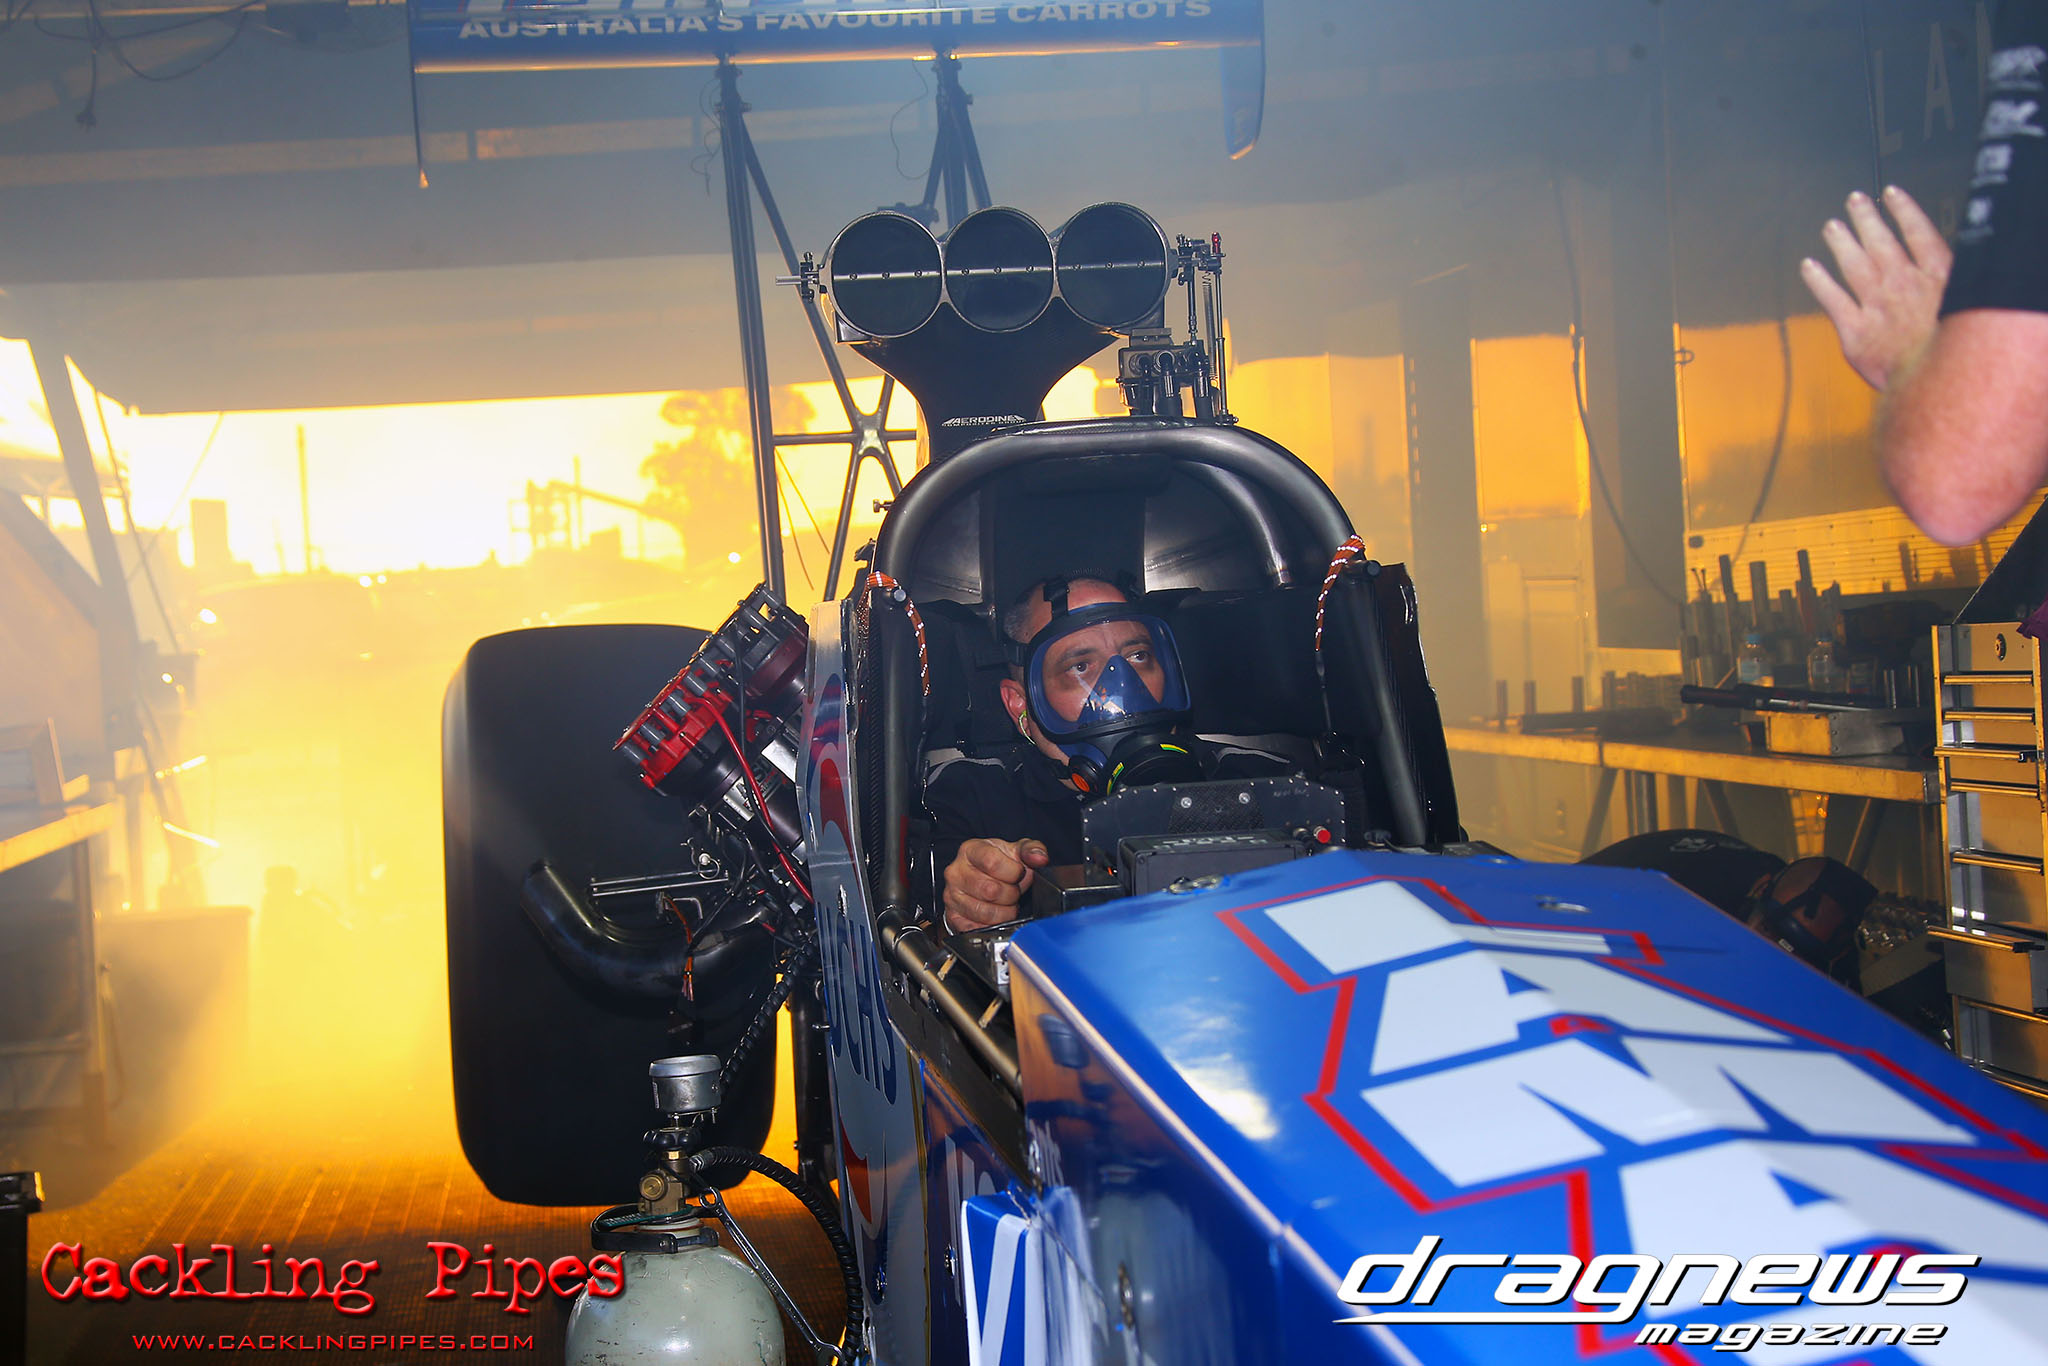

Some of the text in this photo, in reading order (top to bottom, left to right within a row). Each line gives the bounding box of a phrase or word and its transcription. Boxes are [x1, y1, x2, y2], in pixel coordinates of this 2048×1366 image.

[458, 14, 743, 39] AUSTRALIA'S
[756, 7, 996, 31] FAVOURITE
[1007, 0, 1212, 23] CARROTS
[815, 899, 897, 1105] UCHS
